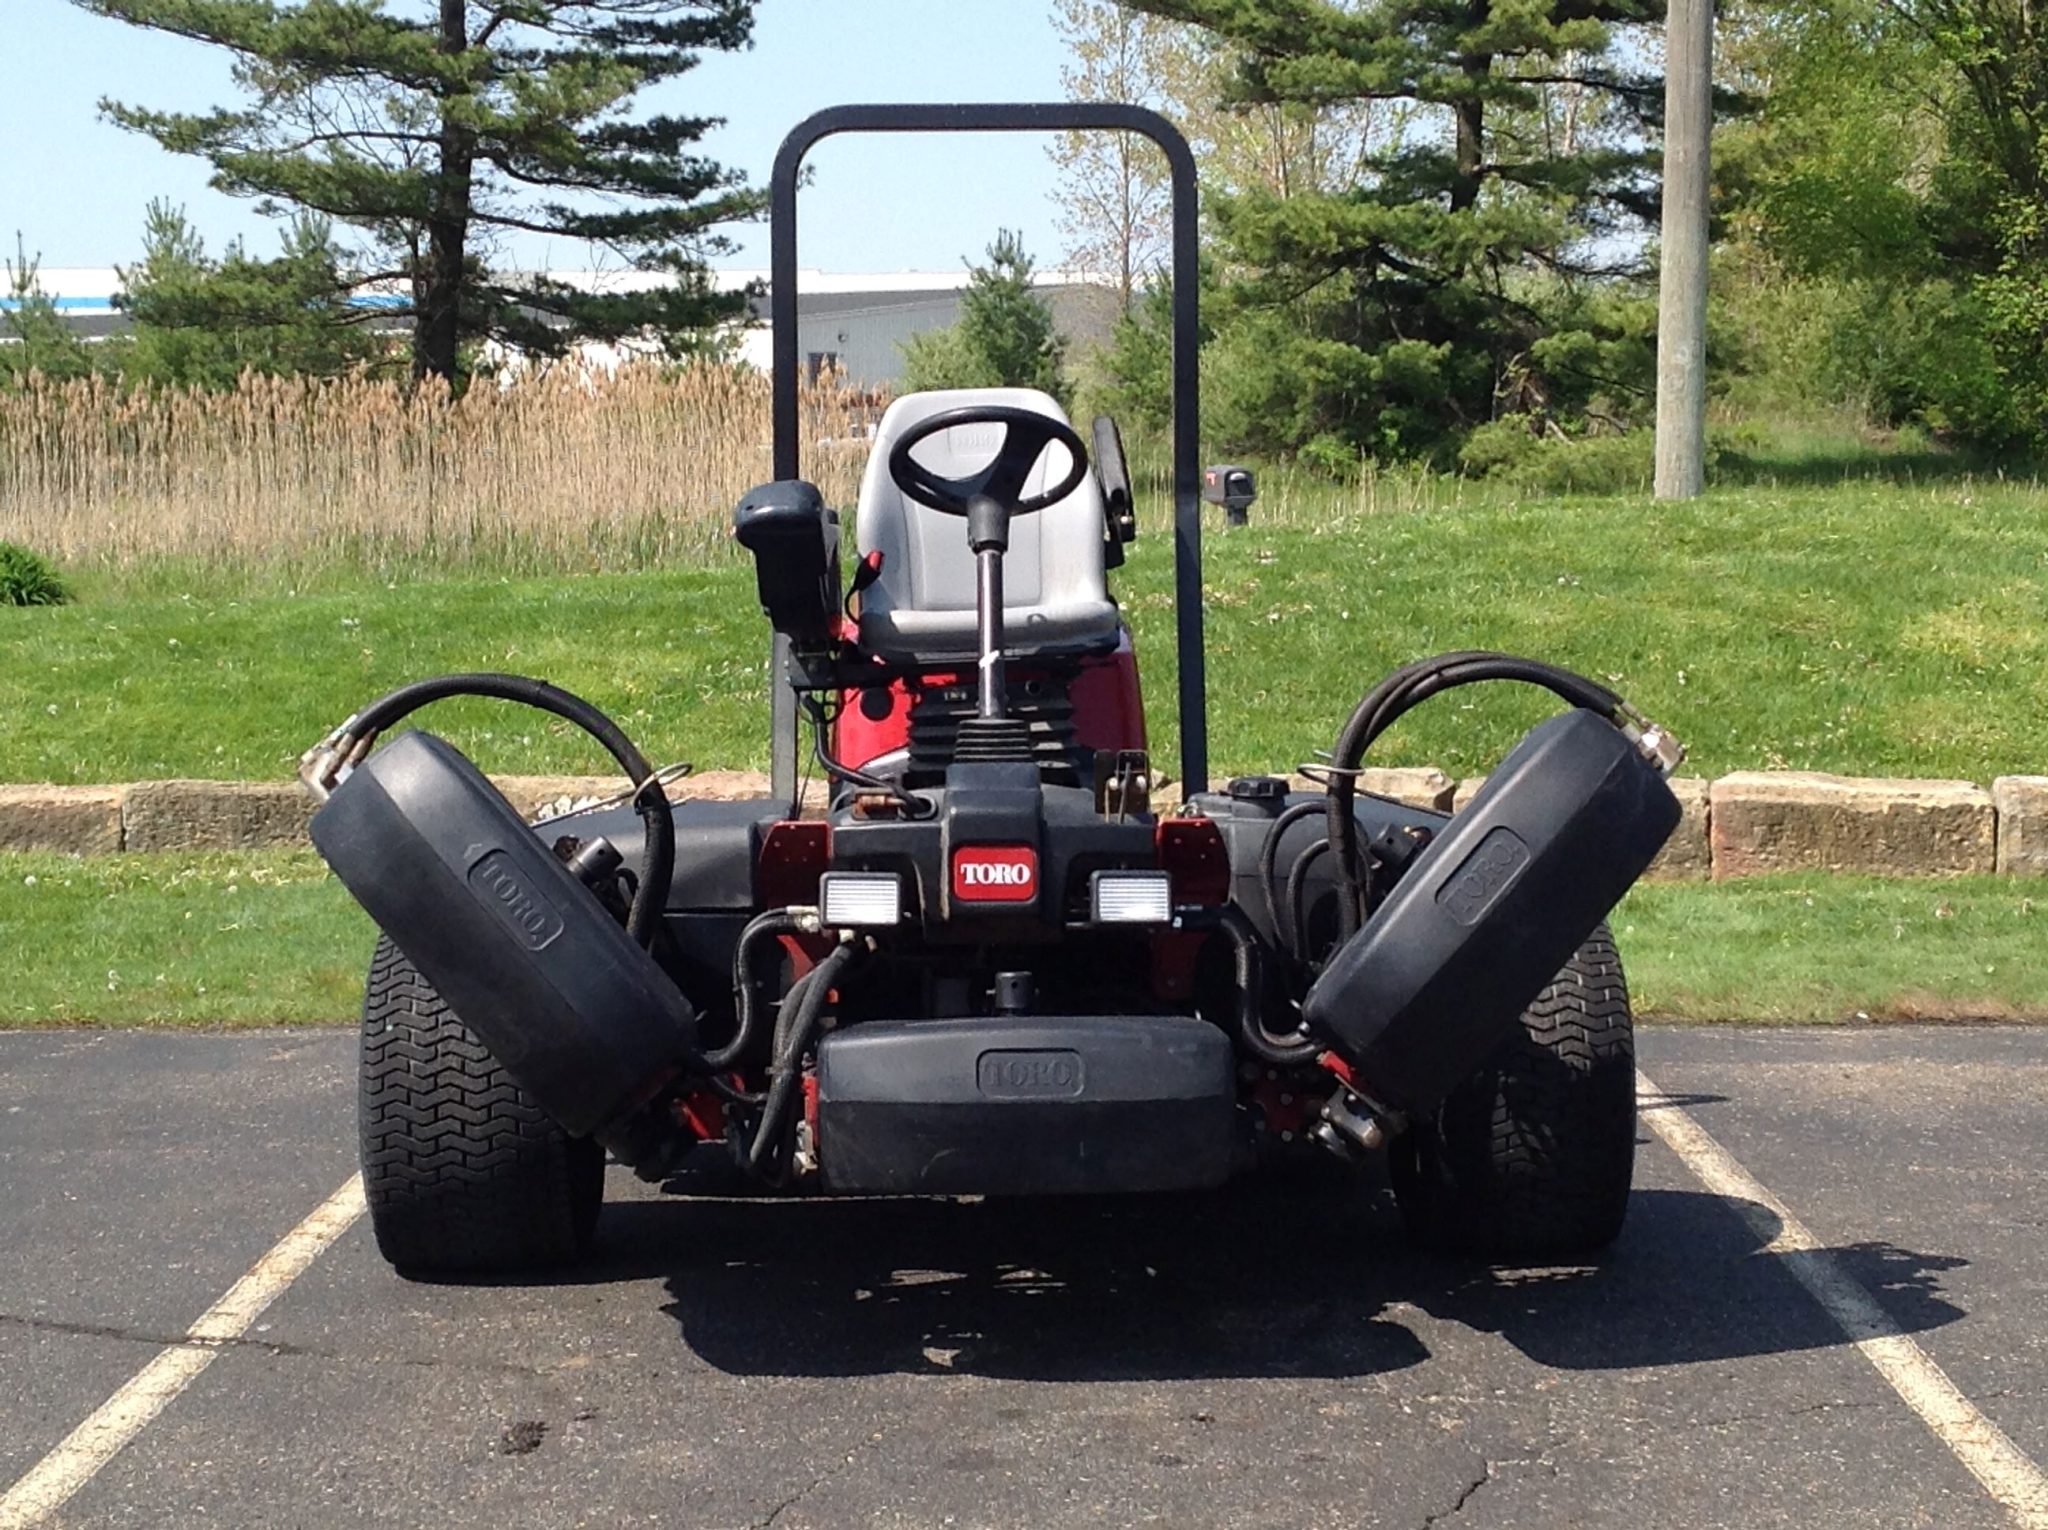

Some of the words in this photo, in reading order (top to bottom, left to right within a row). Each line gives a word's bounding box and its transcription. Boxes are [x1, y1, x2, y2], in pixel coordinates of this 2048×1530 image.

[479, 857, 547, 936] TORO
[960, 863, 1031, 884] TORO
[1443, 840, 1515, 914] TORO
[984, 1061, 1073, 1087] TORO
